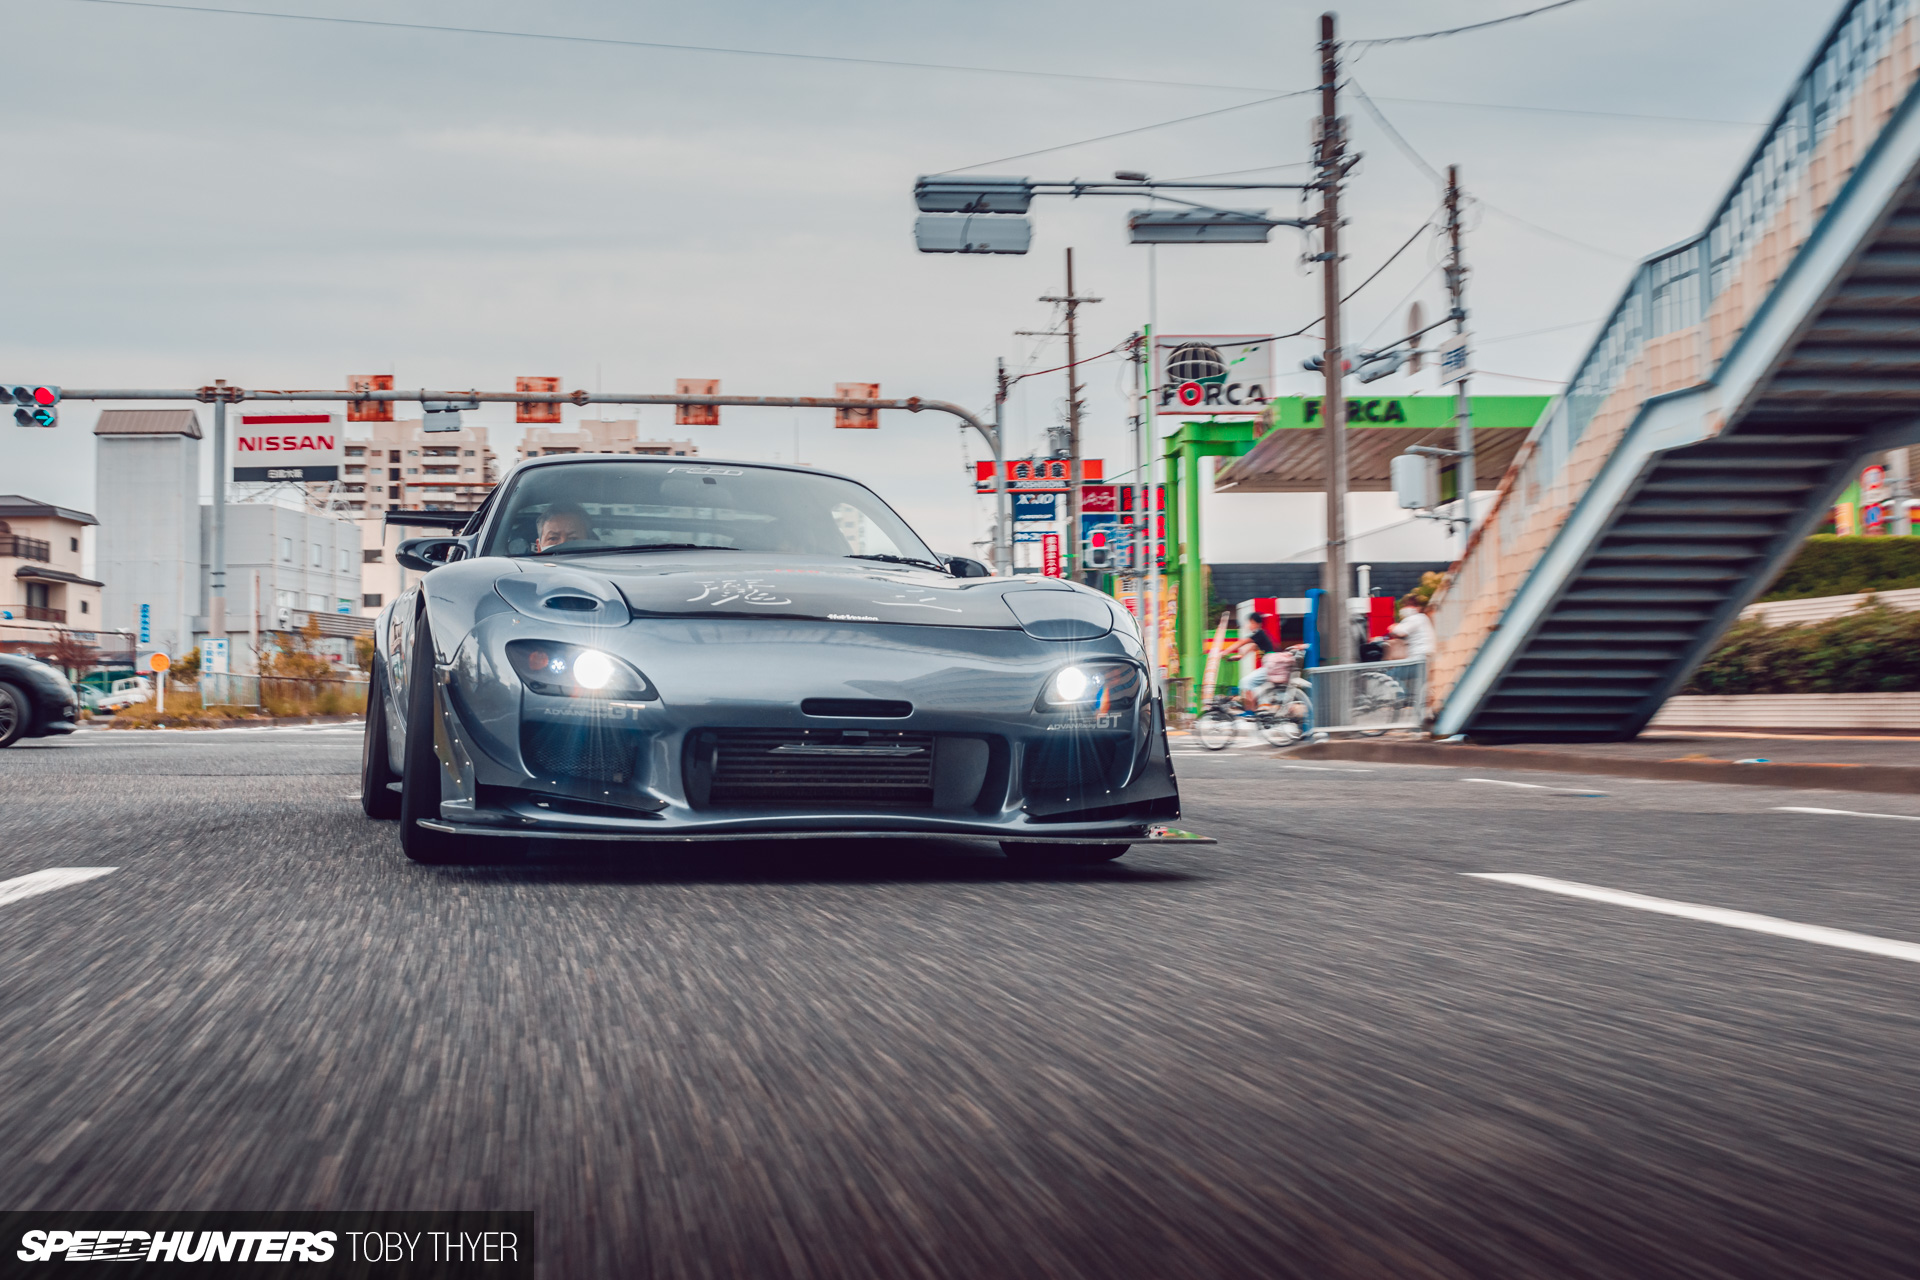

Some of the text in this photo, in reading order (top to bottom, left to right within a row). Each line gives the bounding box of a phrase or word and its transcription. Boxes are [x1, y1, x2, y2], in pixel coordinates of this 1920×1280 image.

[1160, 382, 1267, 407] FORCA
[1302, 400, 1406, 423] FRCA
[238, 435, 334, 452] NISSAN
[543, 707, 586, 717] ADVAN
[608, 702, 647, 721] GT
[1046, 722, 1078, 731] ADVAN
[1097, 712, 1123, 729] GT
